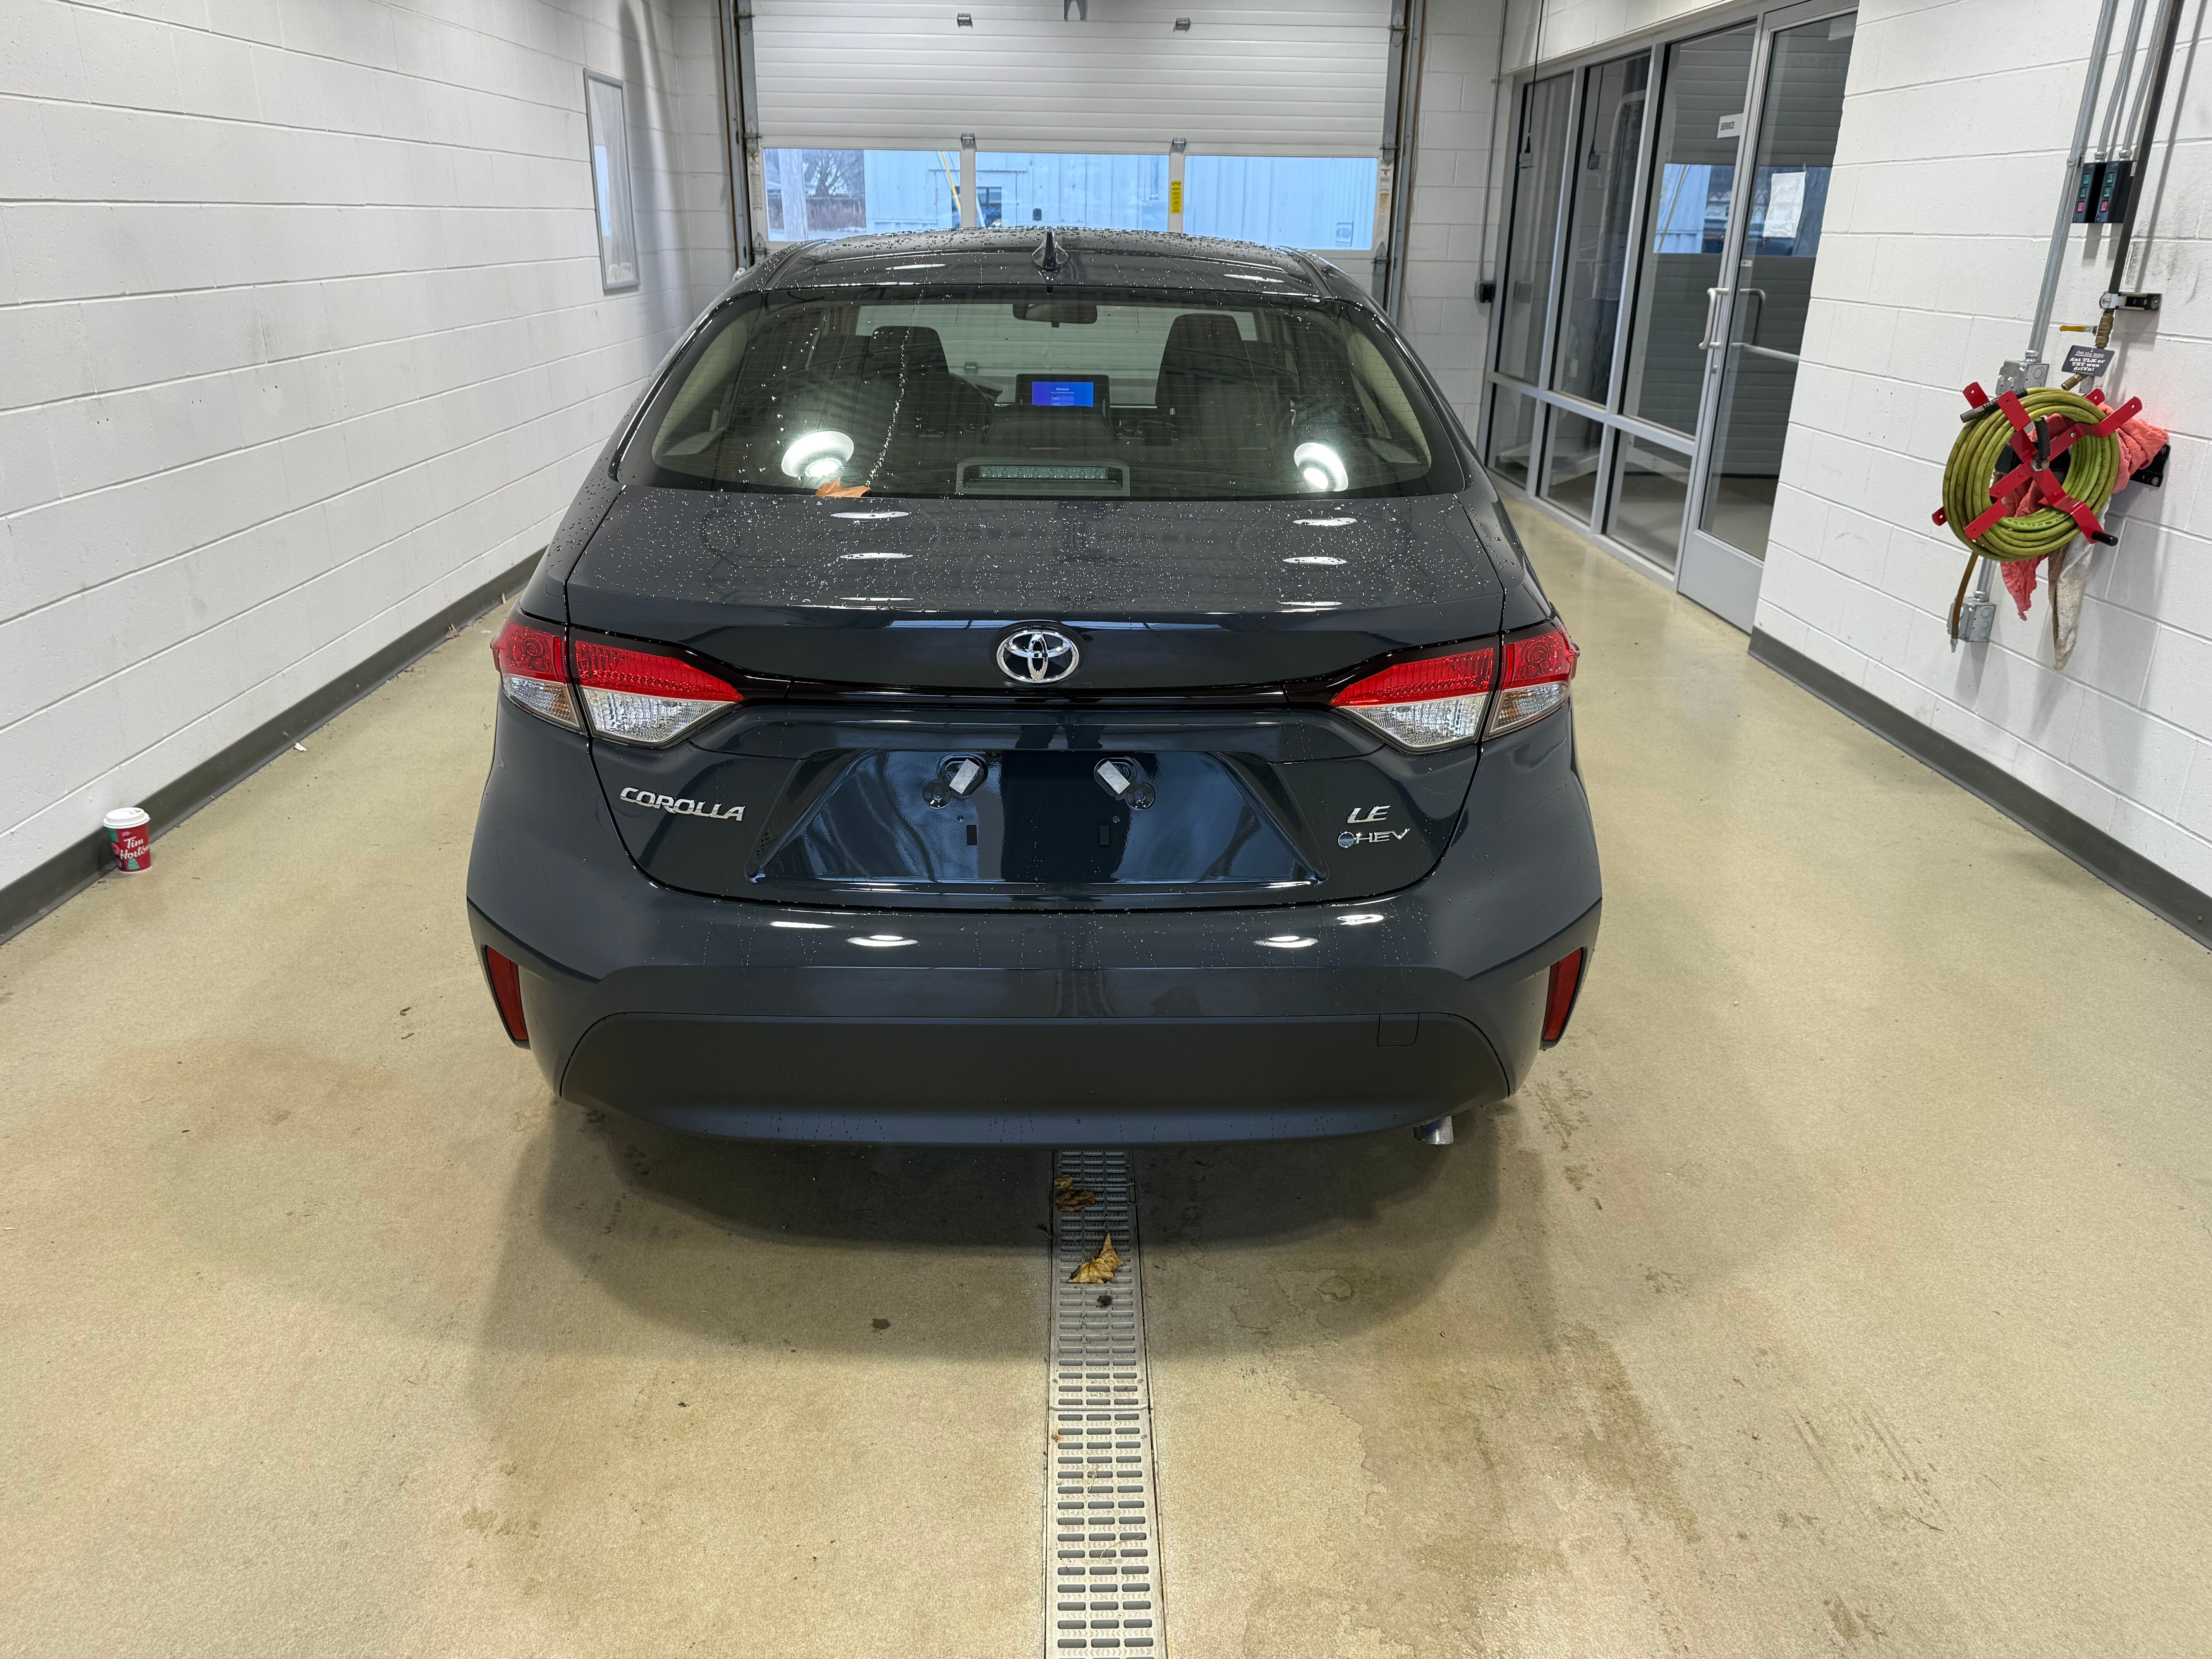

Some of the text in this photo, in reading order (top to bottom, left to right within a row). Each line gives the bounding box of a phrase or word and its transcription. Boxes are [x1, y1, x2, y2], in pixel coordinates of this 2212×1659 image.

[620, 787, 745, 821] COROLLA
[1346, 805, 1391, 824] LE
[123, 836, 144, 849] Tim
[1355, 828, 1410, 845] HEV
[120, 843, 150, 860] Horton
